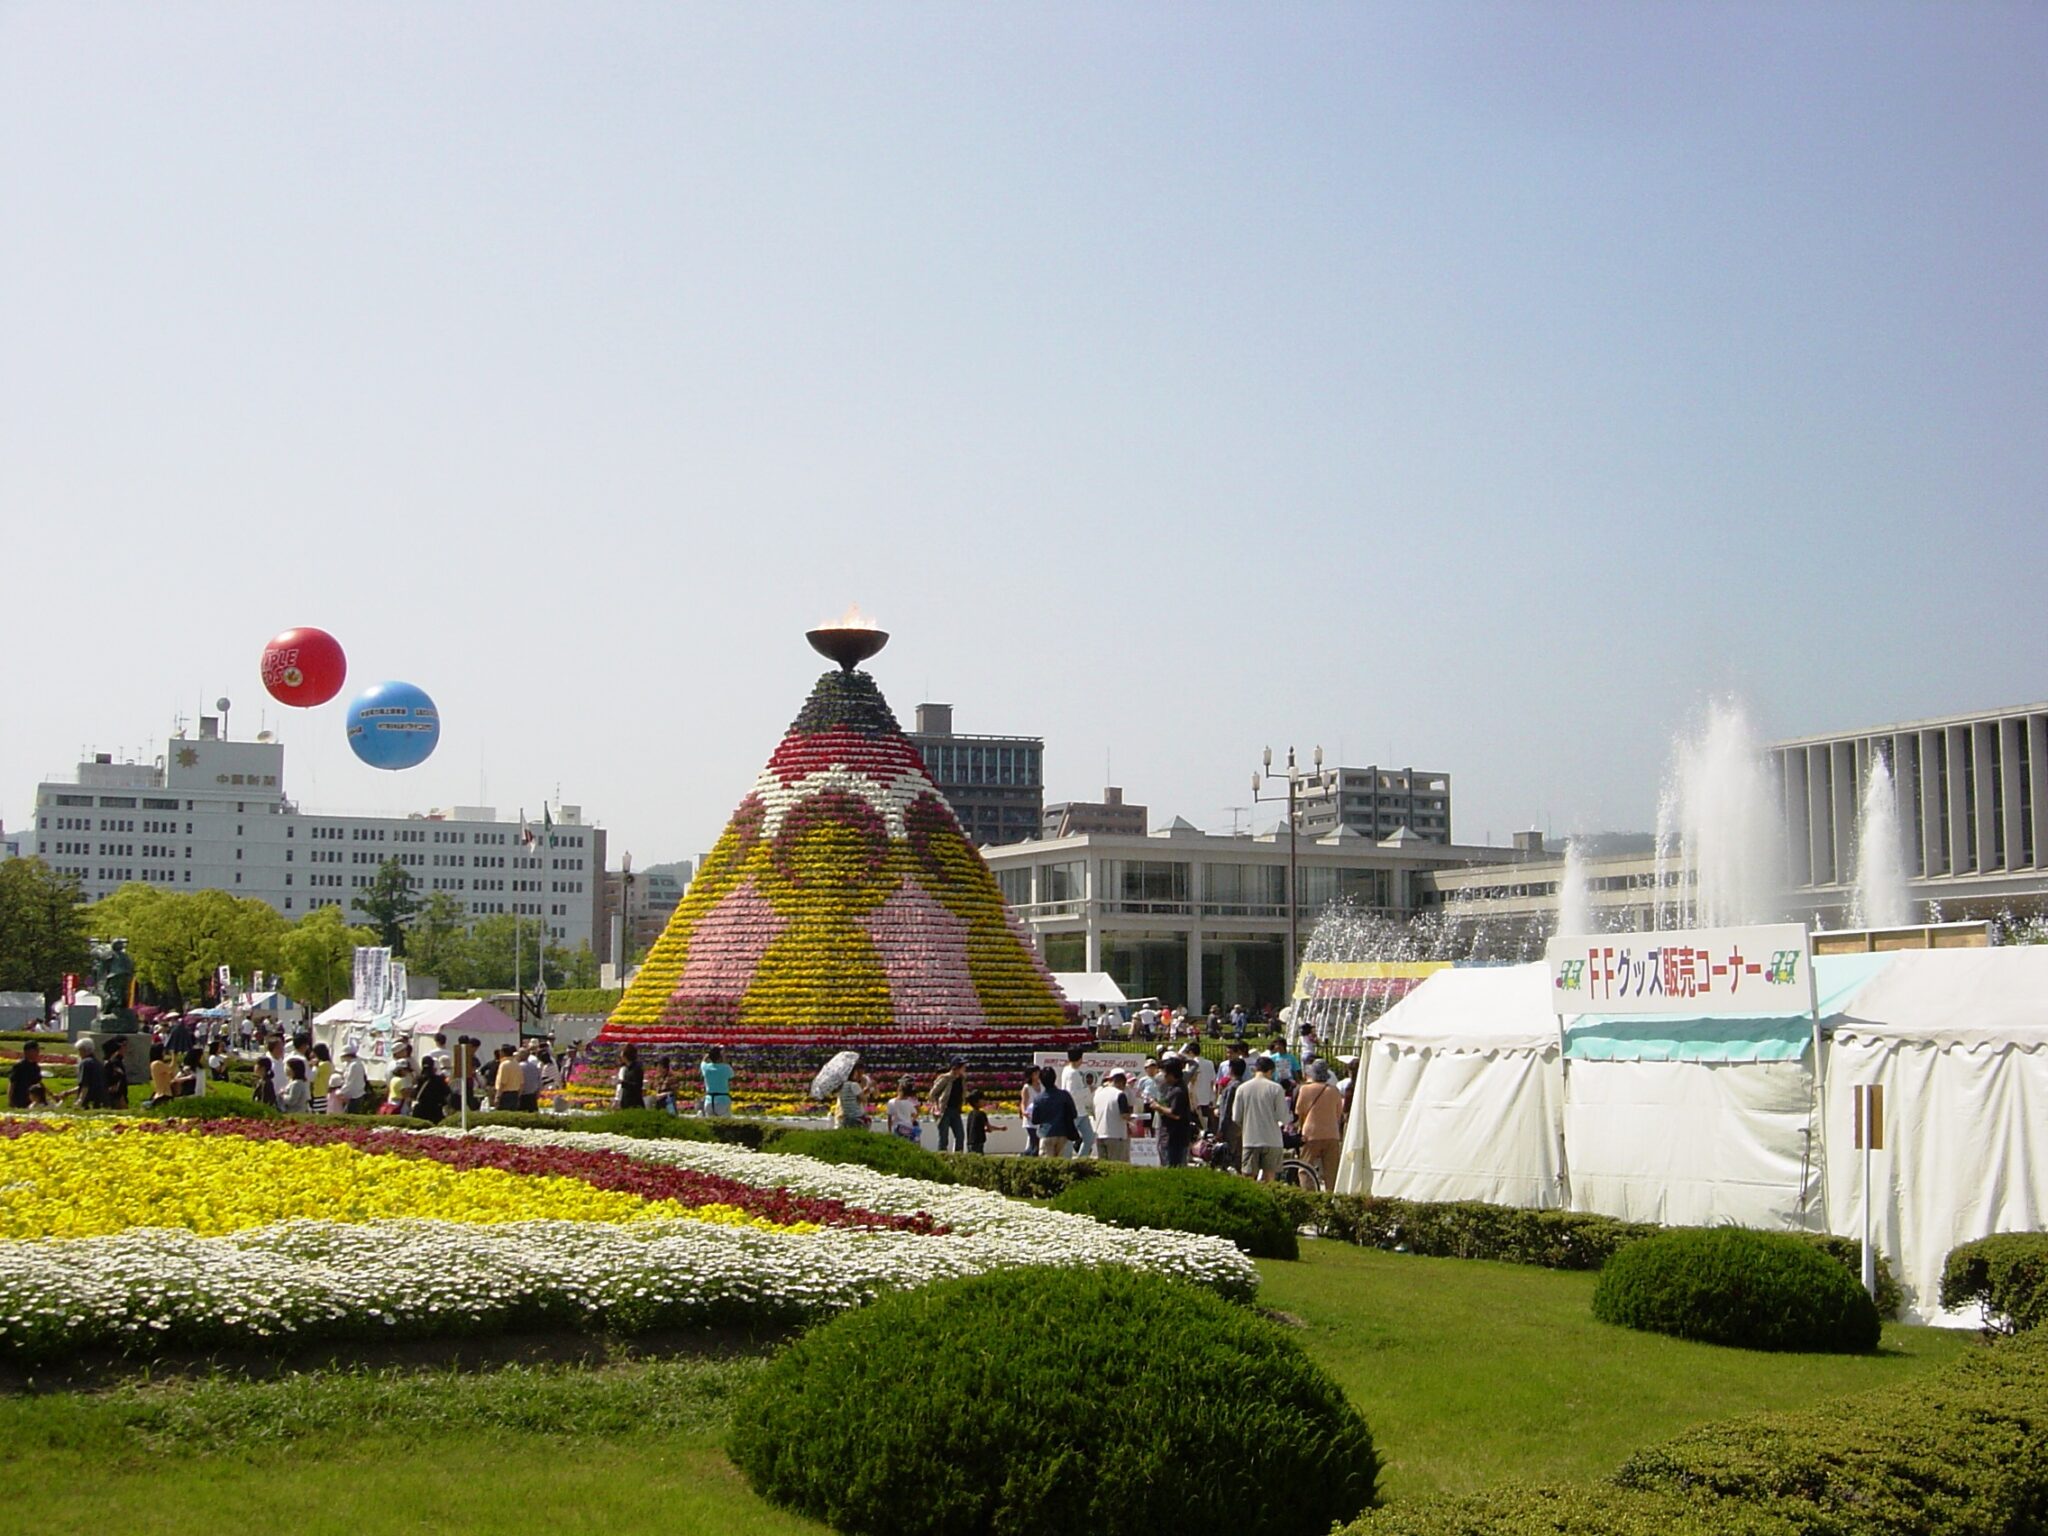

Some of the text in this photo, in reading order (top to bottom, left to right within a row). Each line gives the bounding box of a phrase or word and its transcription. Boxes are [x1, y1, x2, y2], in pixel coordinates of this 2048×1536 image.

[1588, 945, 1761, 1000] FFグッズ販売コーナー
